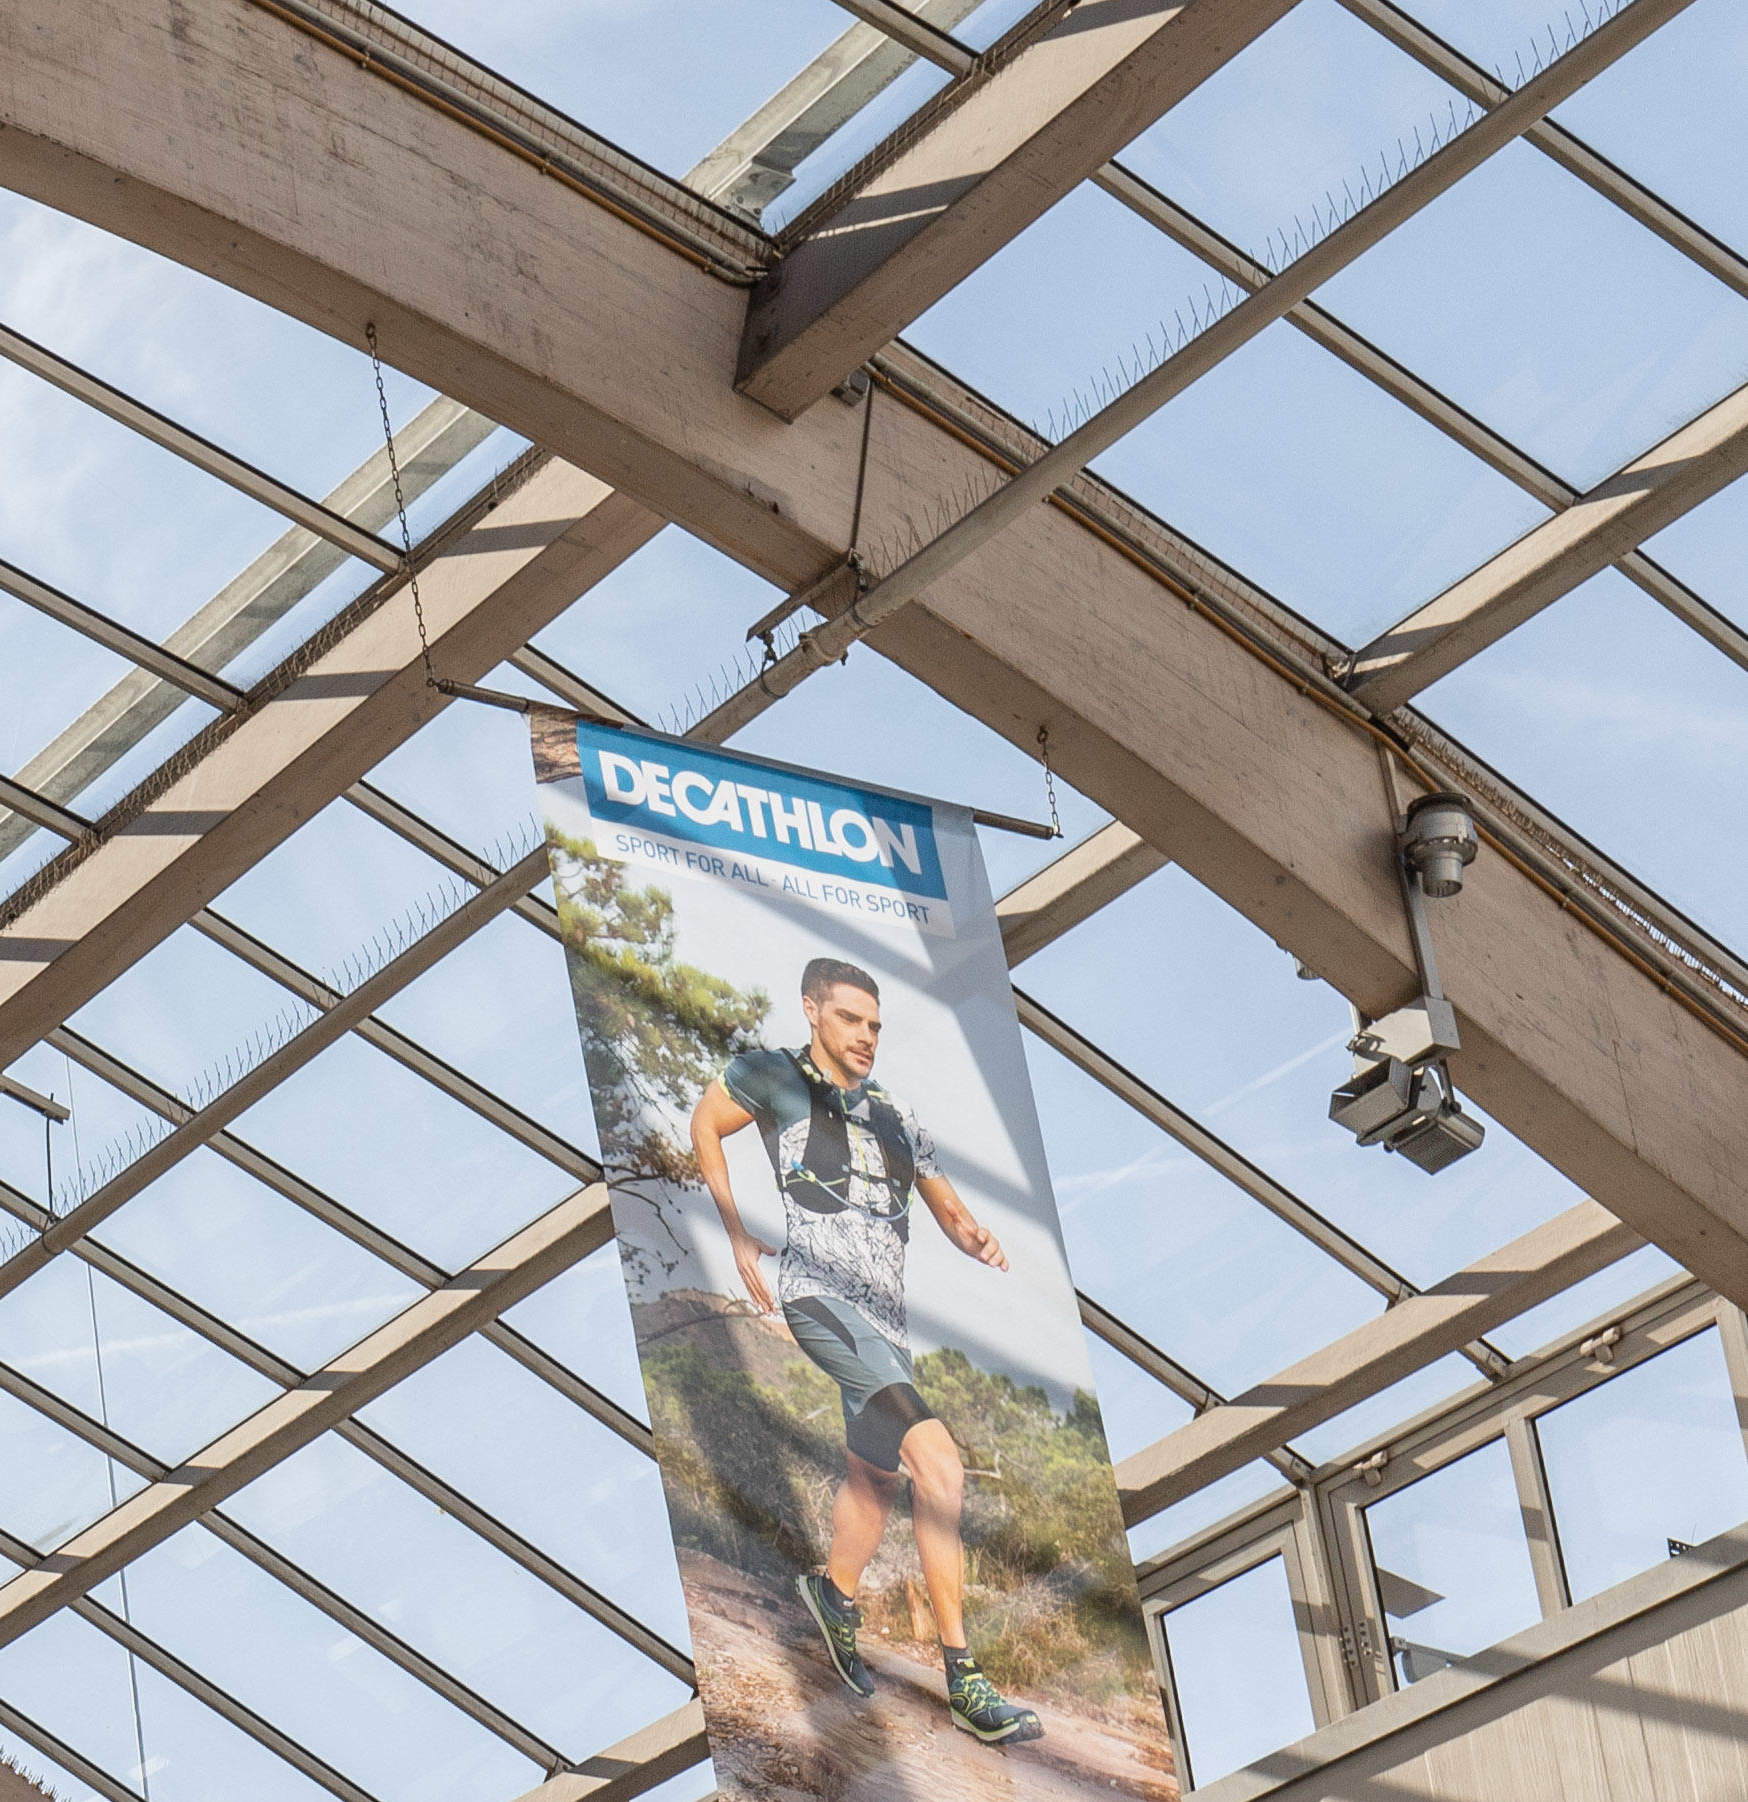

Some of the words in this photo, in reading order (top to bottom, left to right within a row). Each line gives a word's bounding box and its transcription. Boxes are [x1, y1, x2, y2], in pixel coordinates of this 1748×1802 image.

[598, 750, 922, 875] DECATHLON
[615, 834, 679, 866] SPORT
[686, 851, 726, 877] FOR
[731, 862, 769, 887] ALL
[782, 874, 818, 900] ALL
[822, 884, 862, 909] FOR
[866, 894, 929, 924] SPORT
